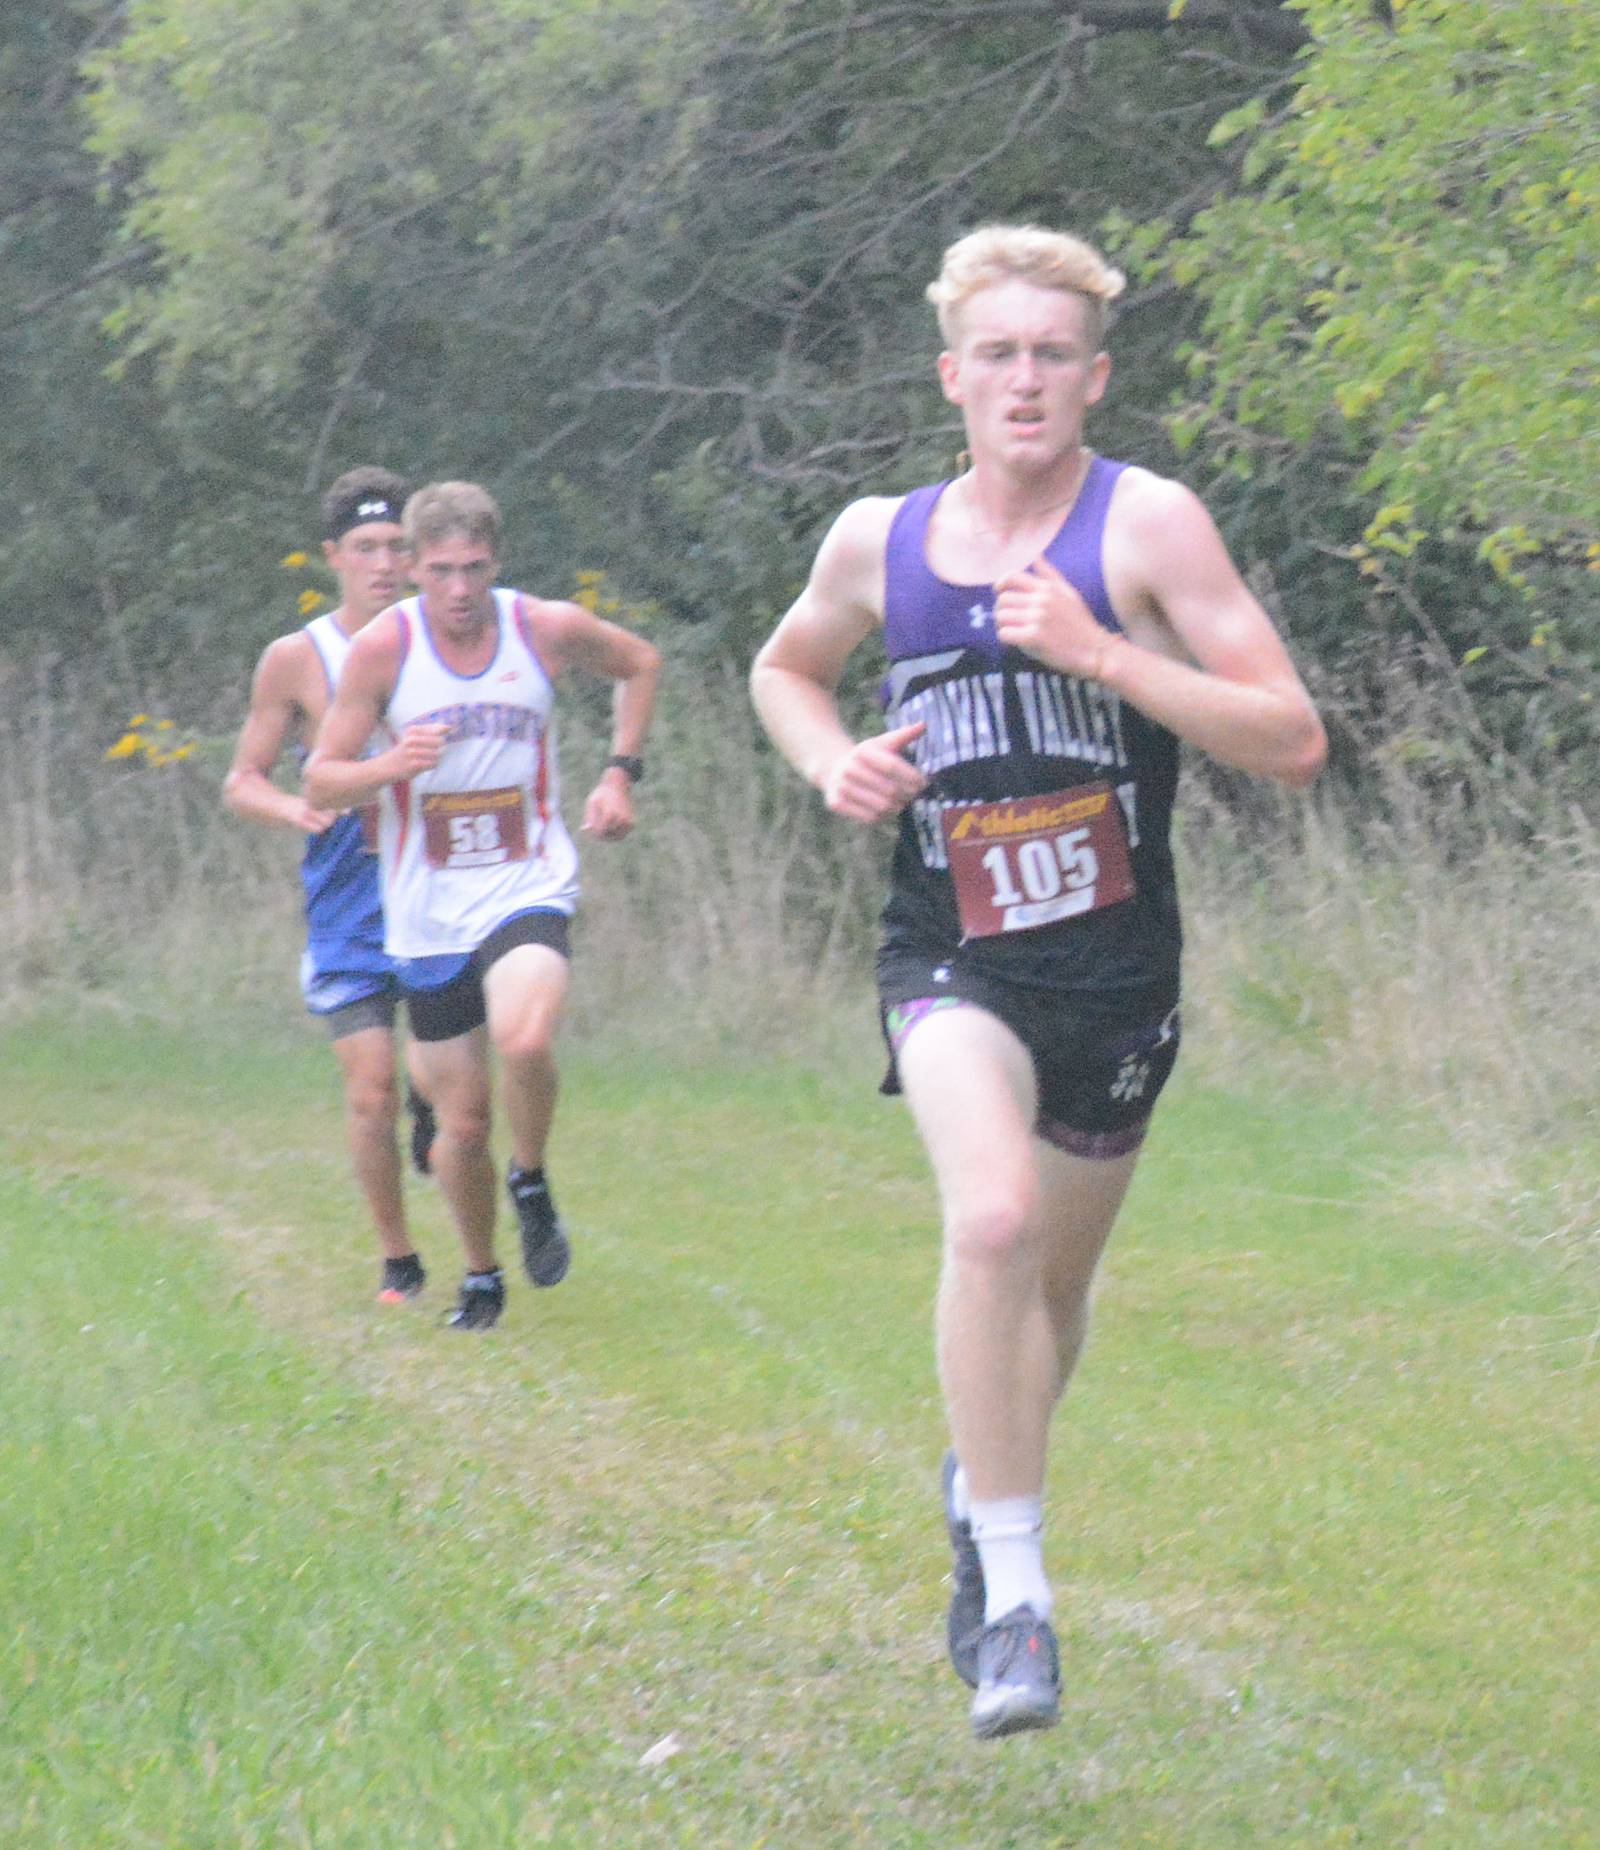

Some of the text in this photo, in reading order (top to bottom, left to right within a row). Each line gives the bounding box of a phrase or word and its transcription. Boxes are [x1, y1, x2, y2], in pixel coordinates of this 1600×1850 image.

[1015, 671, 1129, 768] VALLEY
[448, 813, 500, 852] 58
[982, 827, 1100, 908] 105
